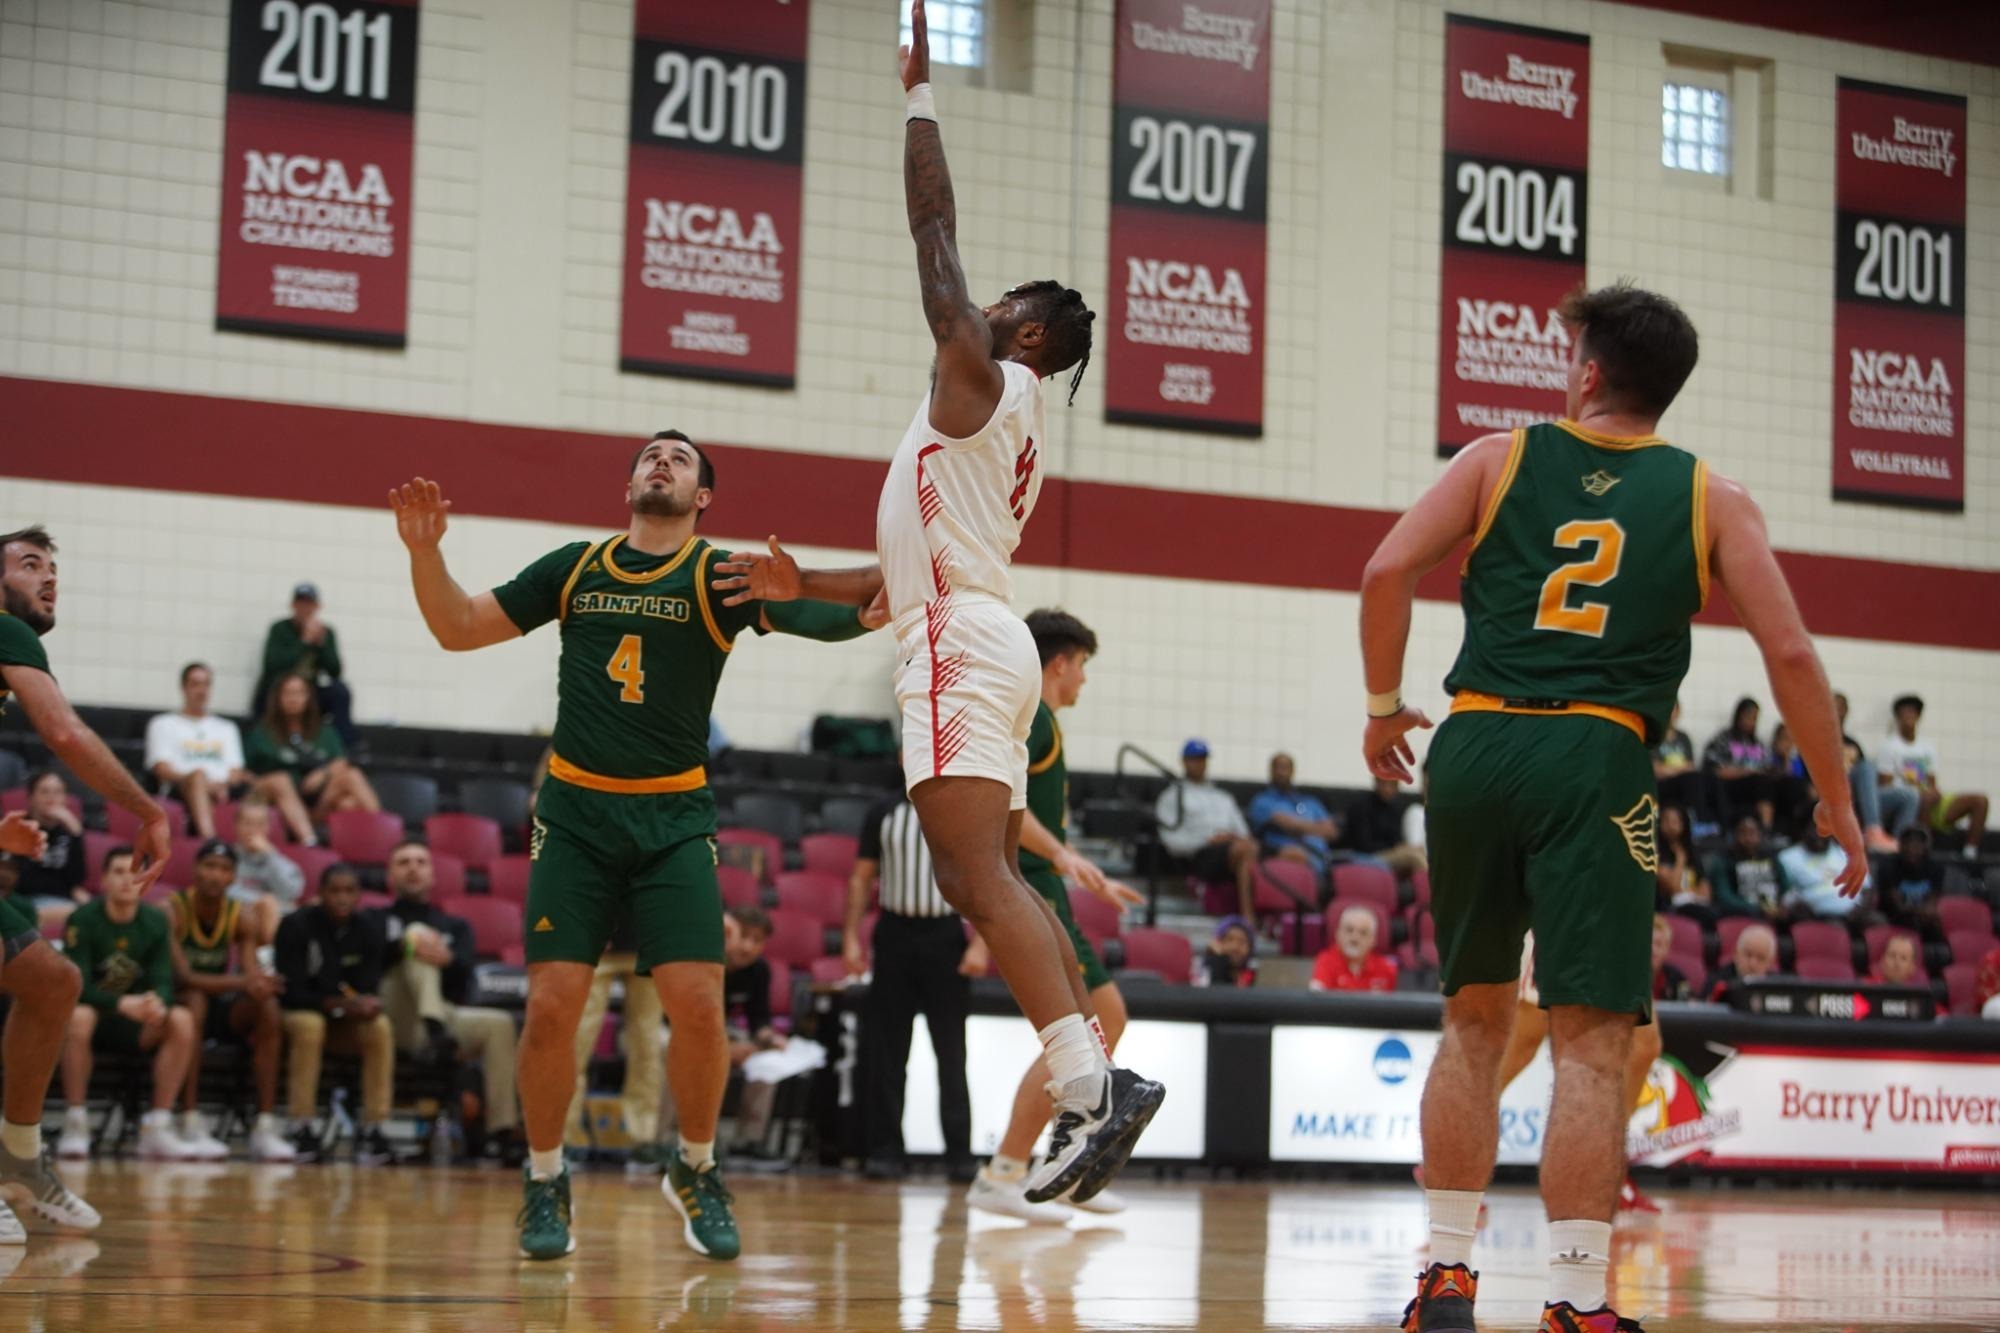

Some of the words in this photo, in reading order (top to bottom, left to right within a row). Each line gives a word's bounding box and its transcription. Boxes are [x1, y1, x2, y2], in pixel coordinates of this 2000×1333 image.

[259, 0, 391, 100] 2011
[1460, 70, 1578, 119] University
[1507, 54, 1575, 93] Barry
[652, 51, 787, 151] 2010
[1851, 132, 1957, 178] University
[1894, 116, 1955, 153] Barry
[243, 150, 393, 206] NCAA
[1129, 116, 1256, 211] 2007
[243, 194, 394, 233] NATIONAL
[643, 198, 782, 253] NCAA
[1457, 162, 1578, 254] 2004
[239, 222, 394, 257] CHAMPIONS
[643, 241, 782, 279] NATIONAL
[641, 267, 783, 302] CHAMPIONS
[1126, 257, 1250, 308] NCAA
[1855, 220, 1951, 306] 2001
[1125, 322, 1252, 354] CHAMPIONS
[1126, 298, 1251, 333] NATIONAL
[1457, 297, 1571, 347] NCAA
[1457, 336, 1570, 372] NATIONAL
[1850, 347, 1952, 394] NCAA
[1849, 406, 1954, 437] CHAMPIONS
[1851, 385, 1953, 418] NATIONAL
[1850, 449, 1951, 480] VOLLEYBALL
[1533, 518, 1626, 639] 2
[573, 592, 642, 614] SAINT
[642, 596, 690, 622] LEO
[606, 634, 645, 704] 4
[1291, 1111, 1377, 1140] MAKE
[1387, 1114, 1412, 1140] IT
[1780, 1080, 1880, 1131] Barry
[1887, 1084, 2000, 1125] Univer
